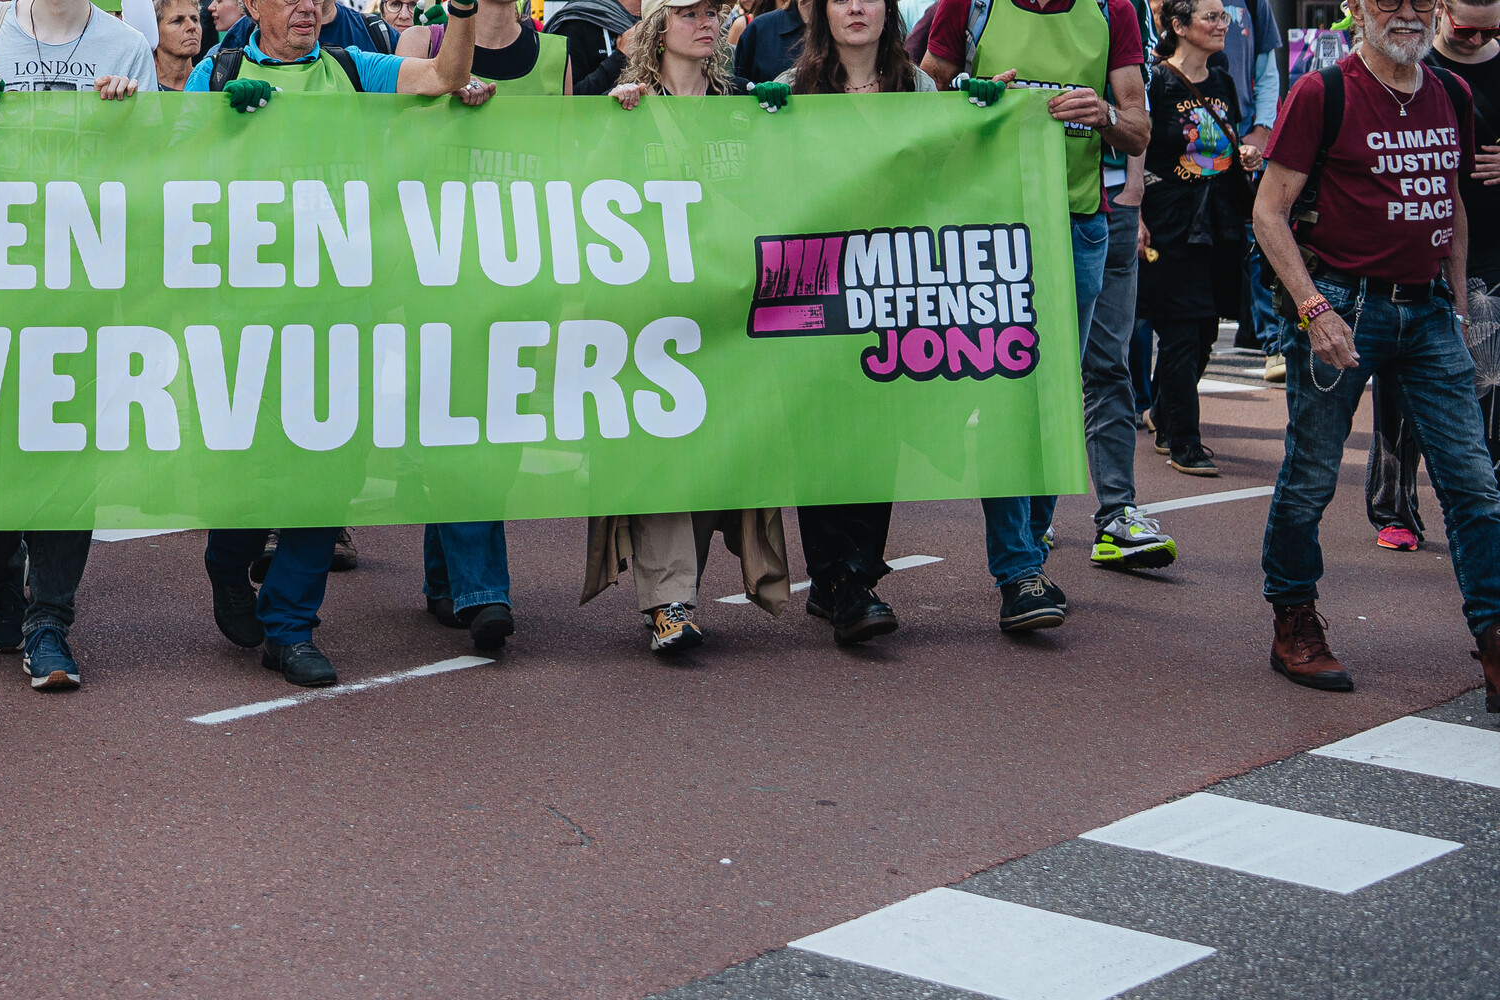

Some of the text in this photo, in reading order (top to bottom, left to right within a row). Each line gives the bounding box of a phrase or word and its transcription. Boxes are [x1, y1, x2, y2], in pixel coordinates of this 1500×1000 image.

[14, 60, 96, 77] LONDON
[1366, 127, 1457, 150] CLIMATE
[1370, 150, 1460, 174] JUSTICE
[1400, 176, 1447, 196] FOR
[1387, 199, 1453, 221] PEACE
[163, 180, 372, 289] EEN
[397, 179, 702, 287] VUIST
[844, 228, 1028, 287] MILIEU
[845, 283, 1033, 329] DEFENSIE
[866, 326, 1035, 375] JONG
